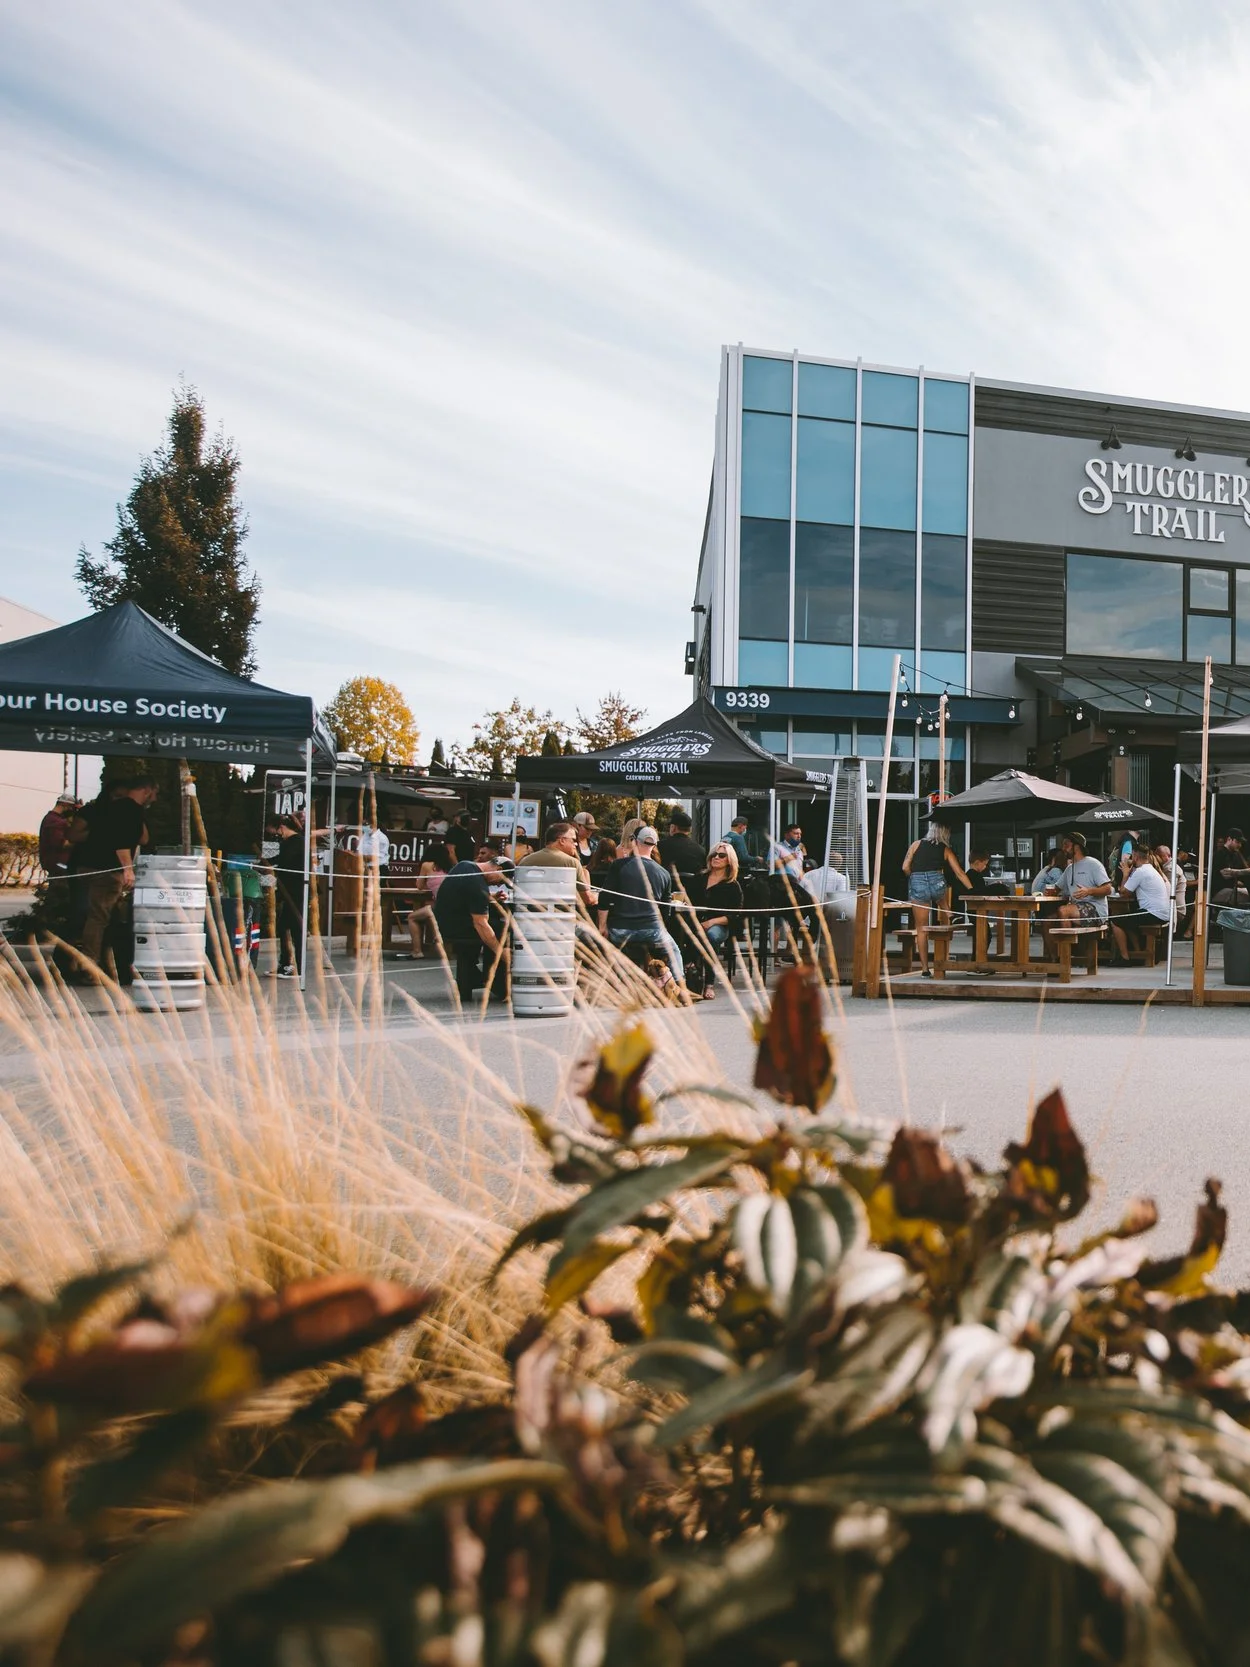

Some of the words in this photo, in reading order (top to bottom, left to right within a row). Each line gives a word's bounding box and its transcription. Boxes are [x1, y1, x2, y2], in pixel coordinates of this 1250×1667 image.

[1125, 501, 1226, 543] TRAIL
[45, 693, 128, 714] House
[136, 698, 227, 723] Society
[726, 691, 770, 709] 9339
[620, 743, 712, 757] SMUGGLERS
[599, 760, 658, 773] SMUGGLERS
[660, 762, 690, 774] TRAIL
